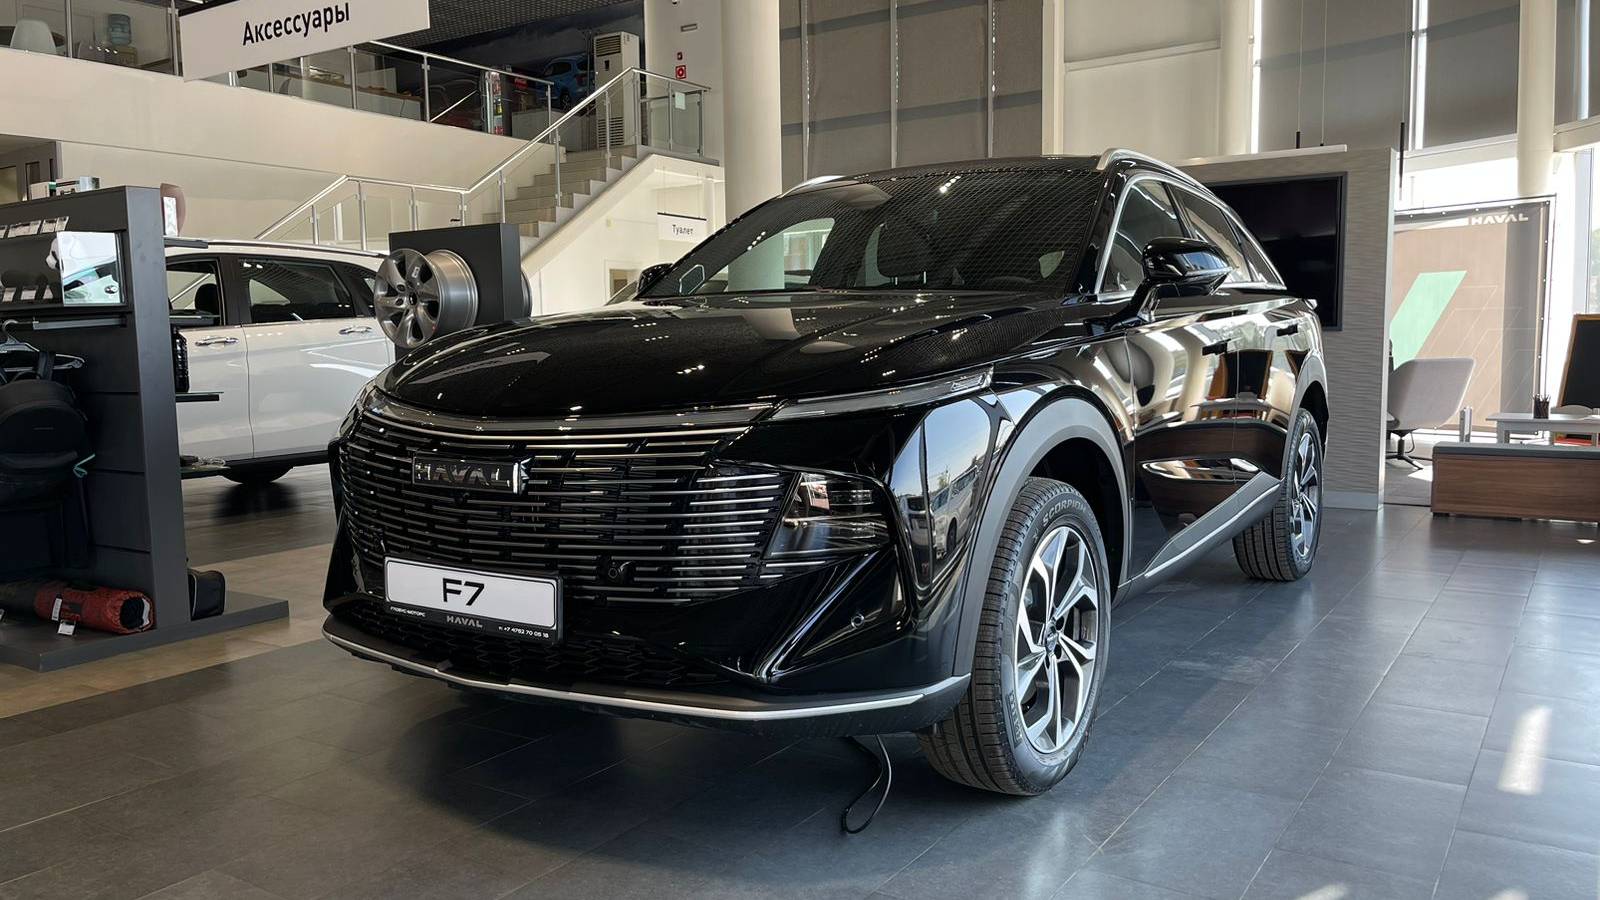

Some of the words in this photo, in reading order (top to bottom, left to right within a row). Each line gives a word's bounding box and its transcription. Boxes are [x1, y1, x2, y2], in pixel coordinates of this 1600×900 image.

[242, 2, 350, 46] Аксессуары
[672, 224, 693, 235] Туалет
[1471, 213, 1529, 225] HAVAL
[415, 462, 511, 488] HAVAL
[1042, 499, 1087, 527] SCORPION
[442, 577, 485, 607] F7
[446, 615, 483, 628] HAVAL
